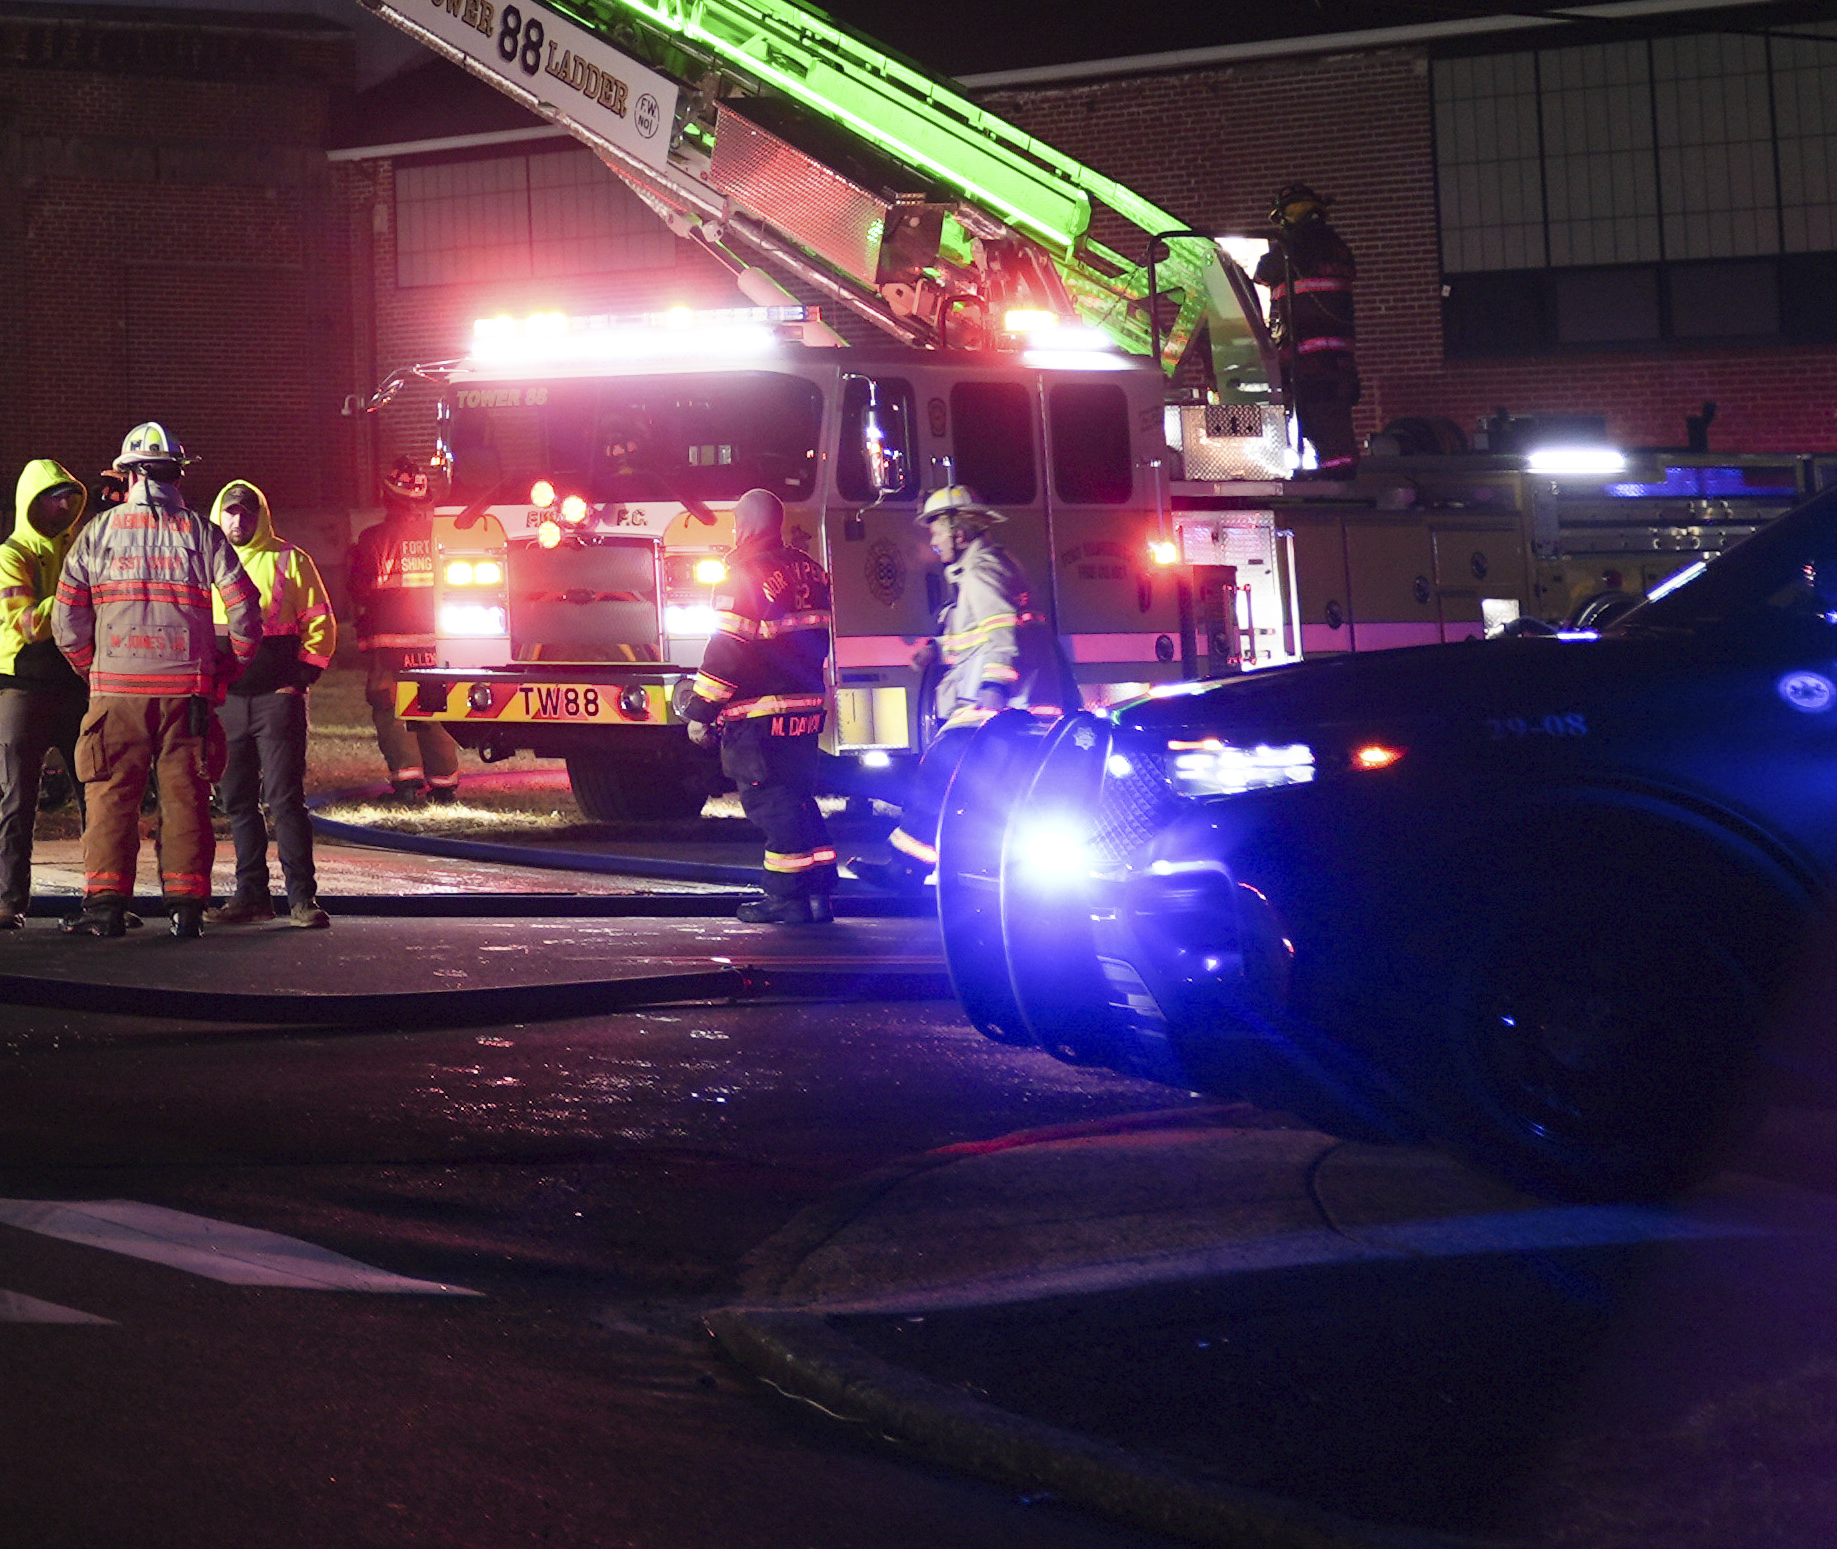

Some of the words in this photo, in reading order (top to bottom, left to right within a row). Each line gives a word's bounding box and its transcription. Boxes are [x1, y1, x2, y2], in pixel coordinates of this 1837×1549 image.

[499, 4, 544, 77] 88
[545, 40, 628, 119] LADDER
[457, 389, 521, 408] TOWER
[402, 539, 430, 555] FORT
[519, 687, 599, 717] TW88
